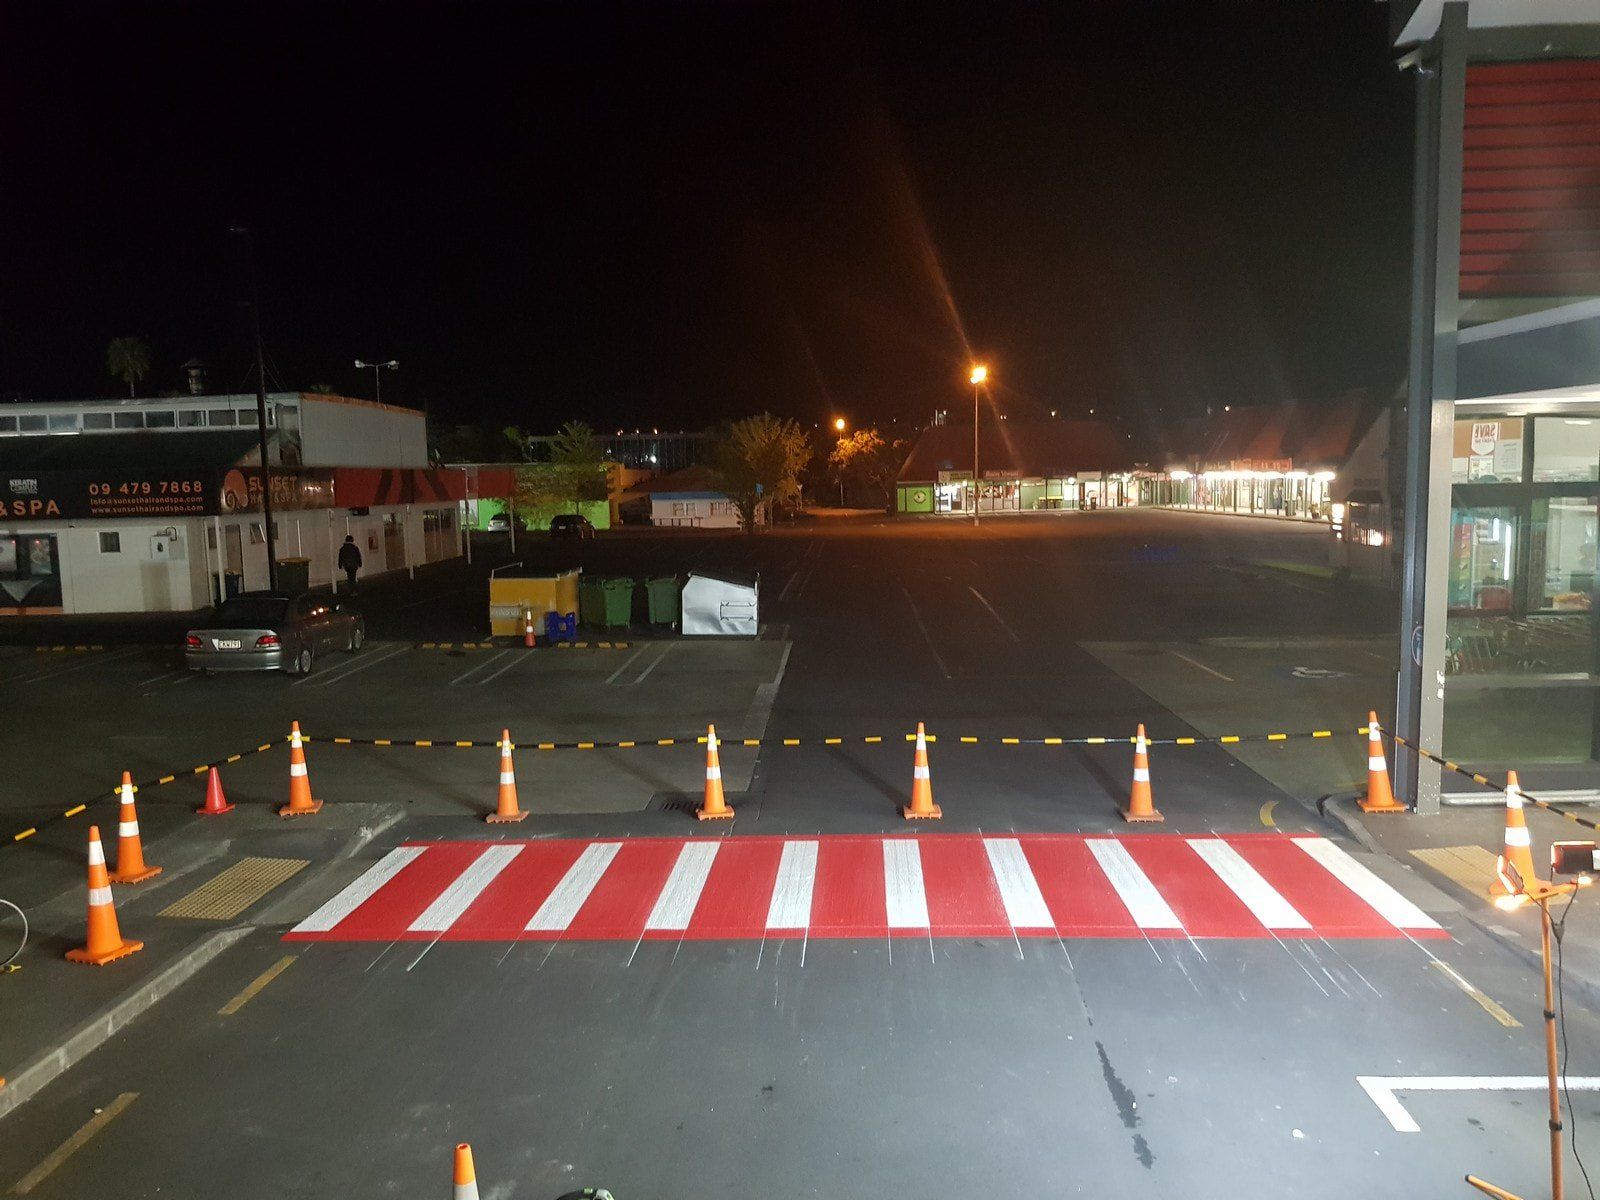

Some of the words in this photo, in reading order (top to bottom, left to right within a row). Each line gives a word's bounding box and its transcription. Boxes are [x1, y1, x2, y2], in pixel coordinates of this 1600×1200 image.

[89, 483, 110, 496] 09
[120, 482, 151, 495] 479
[160, 481, 202, 493] 7868
